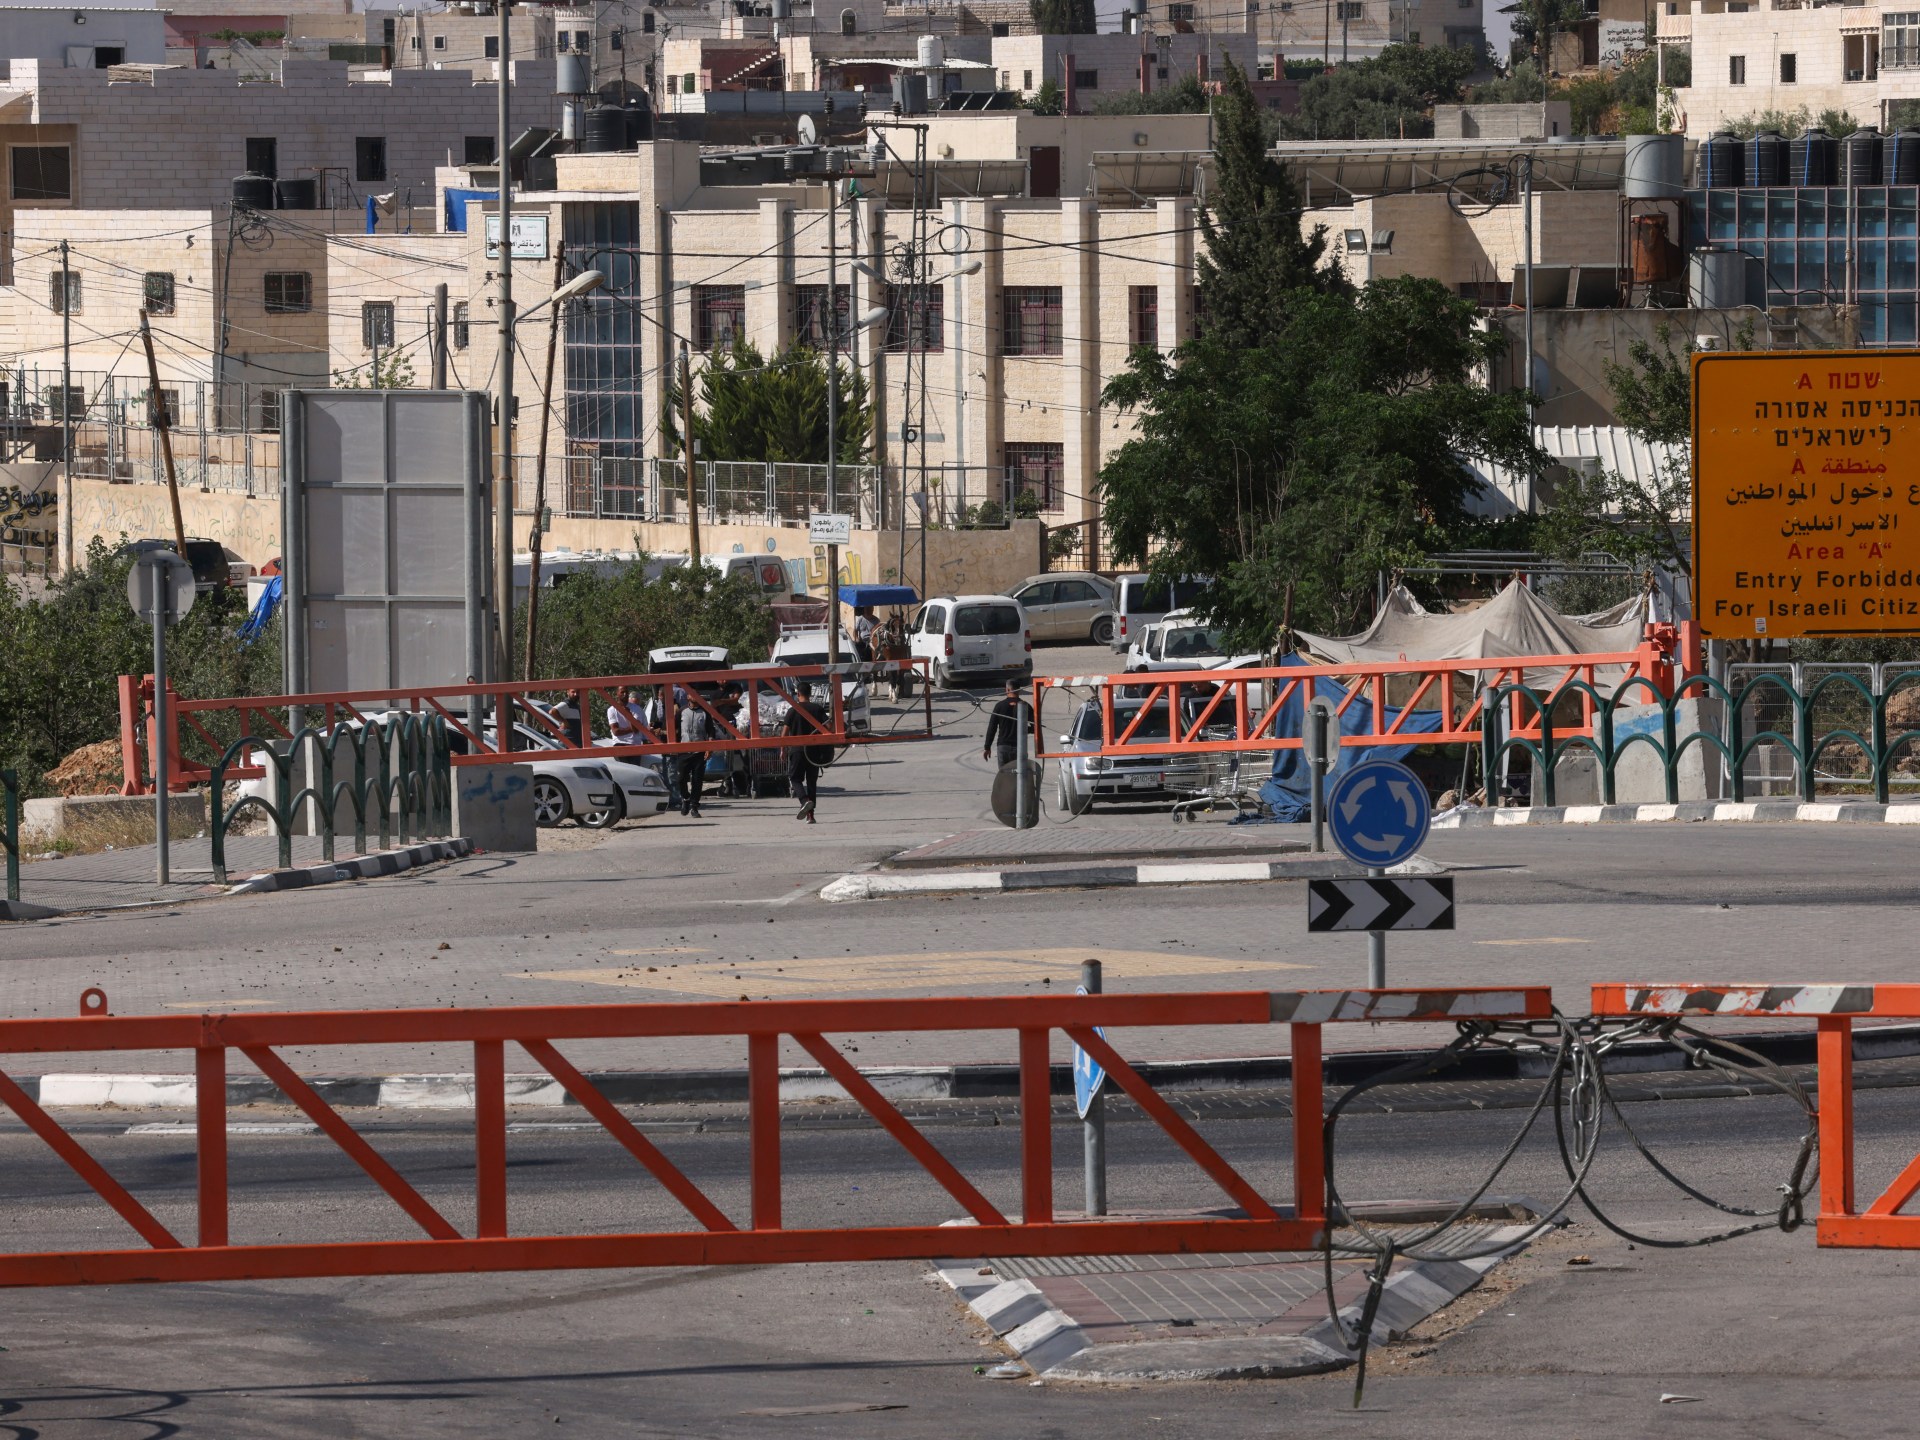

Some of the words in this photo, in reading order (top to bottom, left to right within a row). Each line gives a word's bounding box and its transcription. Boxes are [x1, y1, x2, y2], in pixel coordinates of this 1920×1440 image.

[1798, 373, 1812, 389] A
[1828, 372, 1880, 389] שטח
[1756, 401, 1827, 418] אסורה
[1842, 400, 1920, 417] הכניסה
[1776, 426, 1890, 446] לישראלים
[1791, 458, 1806, 475] A
[1821, 457, 1887, 474] منطقة
[1726, 483, 1815, 505] المواطنين
[1830, 482, 1893, 505] دخول
[1787, 543, 1844, 559] Area
[1736, 572, 1802, 592] Entry
[1715, 600, 1754, 616] For
[1769, 599, 1846, 616] Israeli
